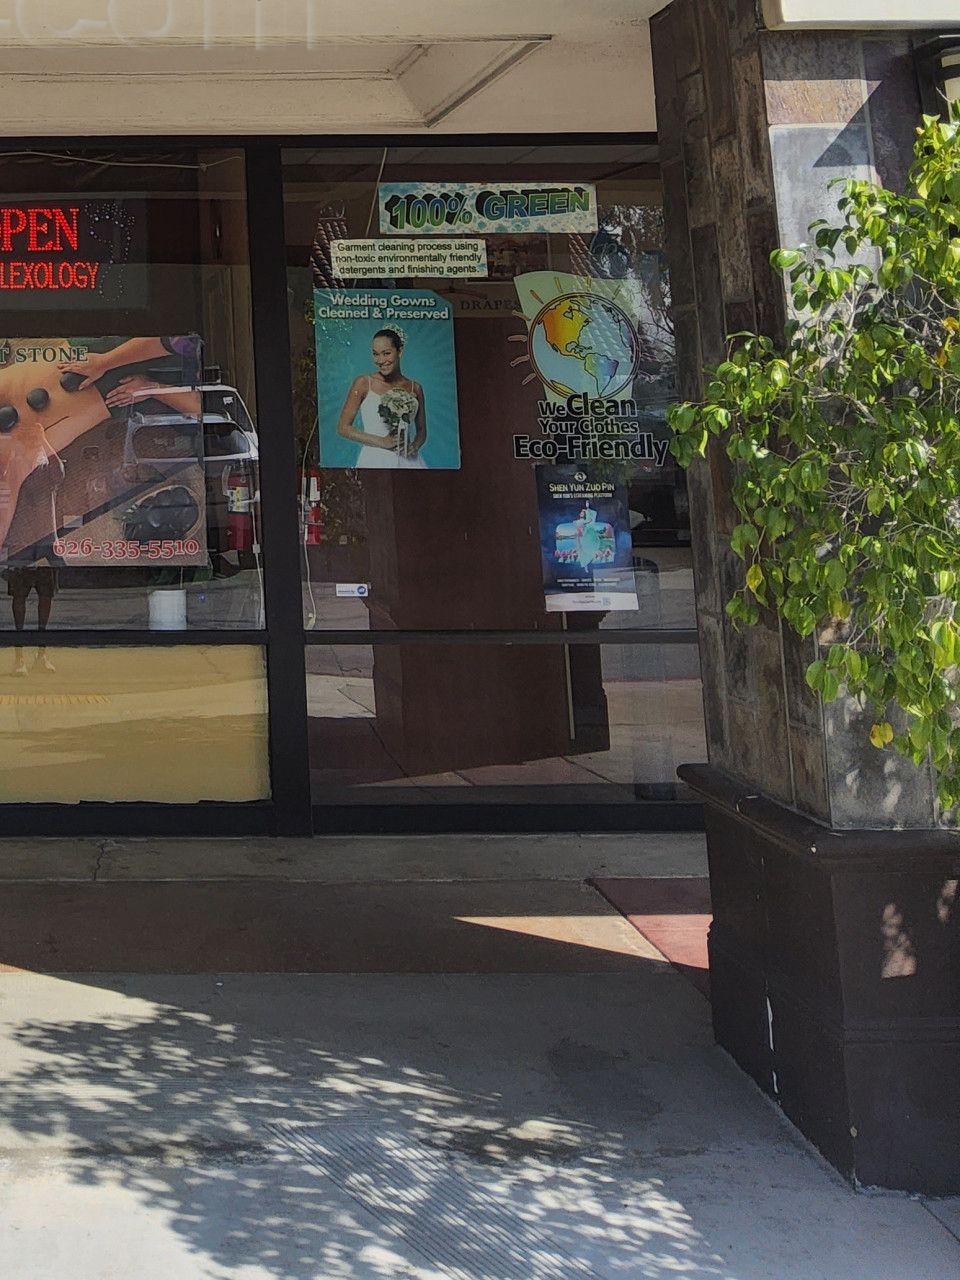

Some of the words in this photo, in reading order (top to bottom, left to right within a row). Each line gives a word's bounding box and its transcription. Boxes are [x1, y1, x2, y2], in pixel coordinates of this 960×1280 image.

[385, 193, 473, 230] 100%
[478, 188, 591, 221] GREEN
[337, 242, 376, 252] Garment
[378, 242, 415, 254] cleaning
[417, 244, 454, 255] process
[455, 243, 479, 254] using
[335, 254, 376, 263] non-toxic
[378, 253, 447, 265] environmentally
[448, 253, 482, 264] friendly
[339, 264, 387, 276] detergents
[388, 264, 406, 274] and
[407, 264, 445, 275] finishing
[447, 265, 480, 276] agents.
[332, 294, 388, 308] Wedding
[391, 294, 436, 306] Gowns
[319, 307, 369, 318] Cleaned
[372, 307, 382, 318] &
[386, 307, 449, 319] Preserved
[15, 346, 89, 364] STONE
[538, 400, 567, 417] We
[566, 391, 637, 417] Clean
[538, 418, 577, 435] Your
[578, 417, 640, 435] Clothes
[513, 433, 669, 467] Eco-Friendly
[549, 483, 568, 493] SHEN
[569, 483, 585, 492] YUN
[585, 482, 601, 492] ZUO
[602, 482, 615, 492] PIN
[53, 538, 199, 559] 626-335-5510
